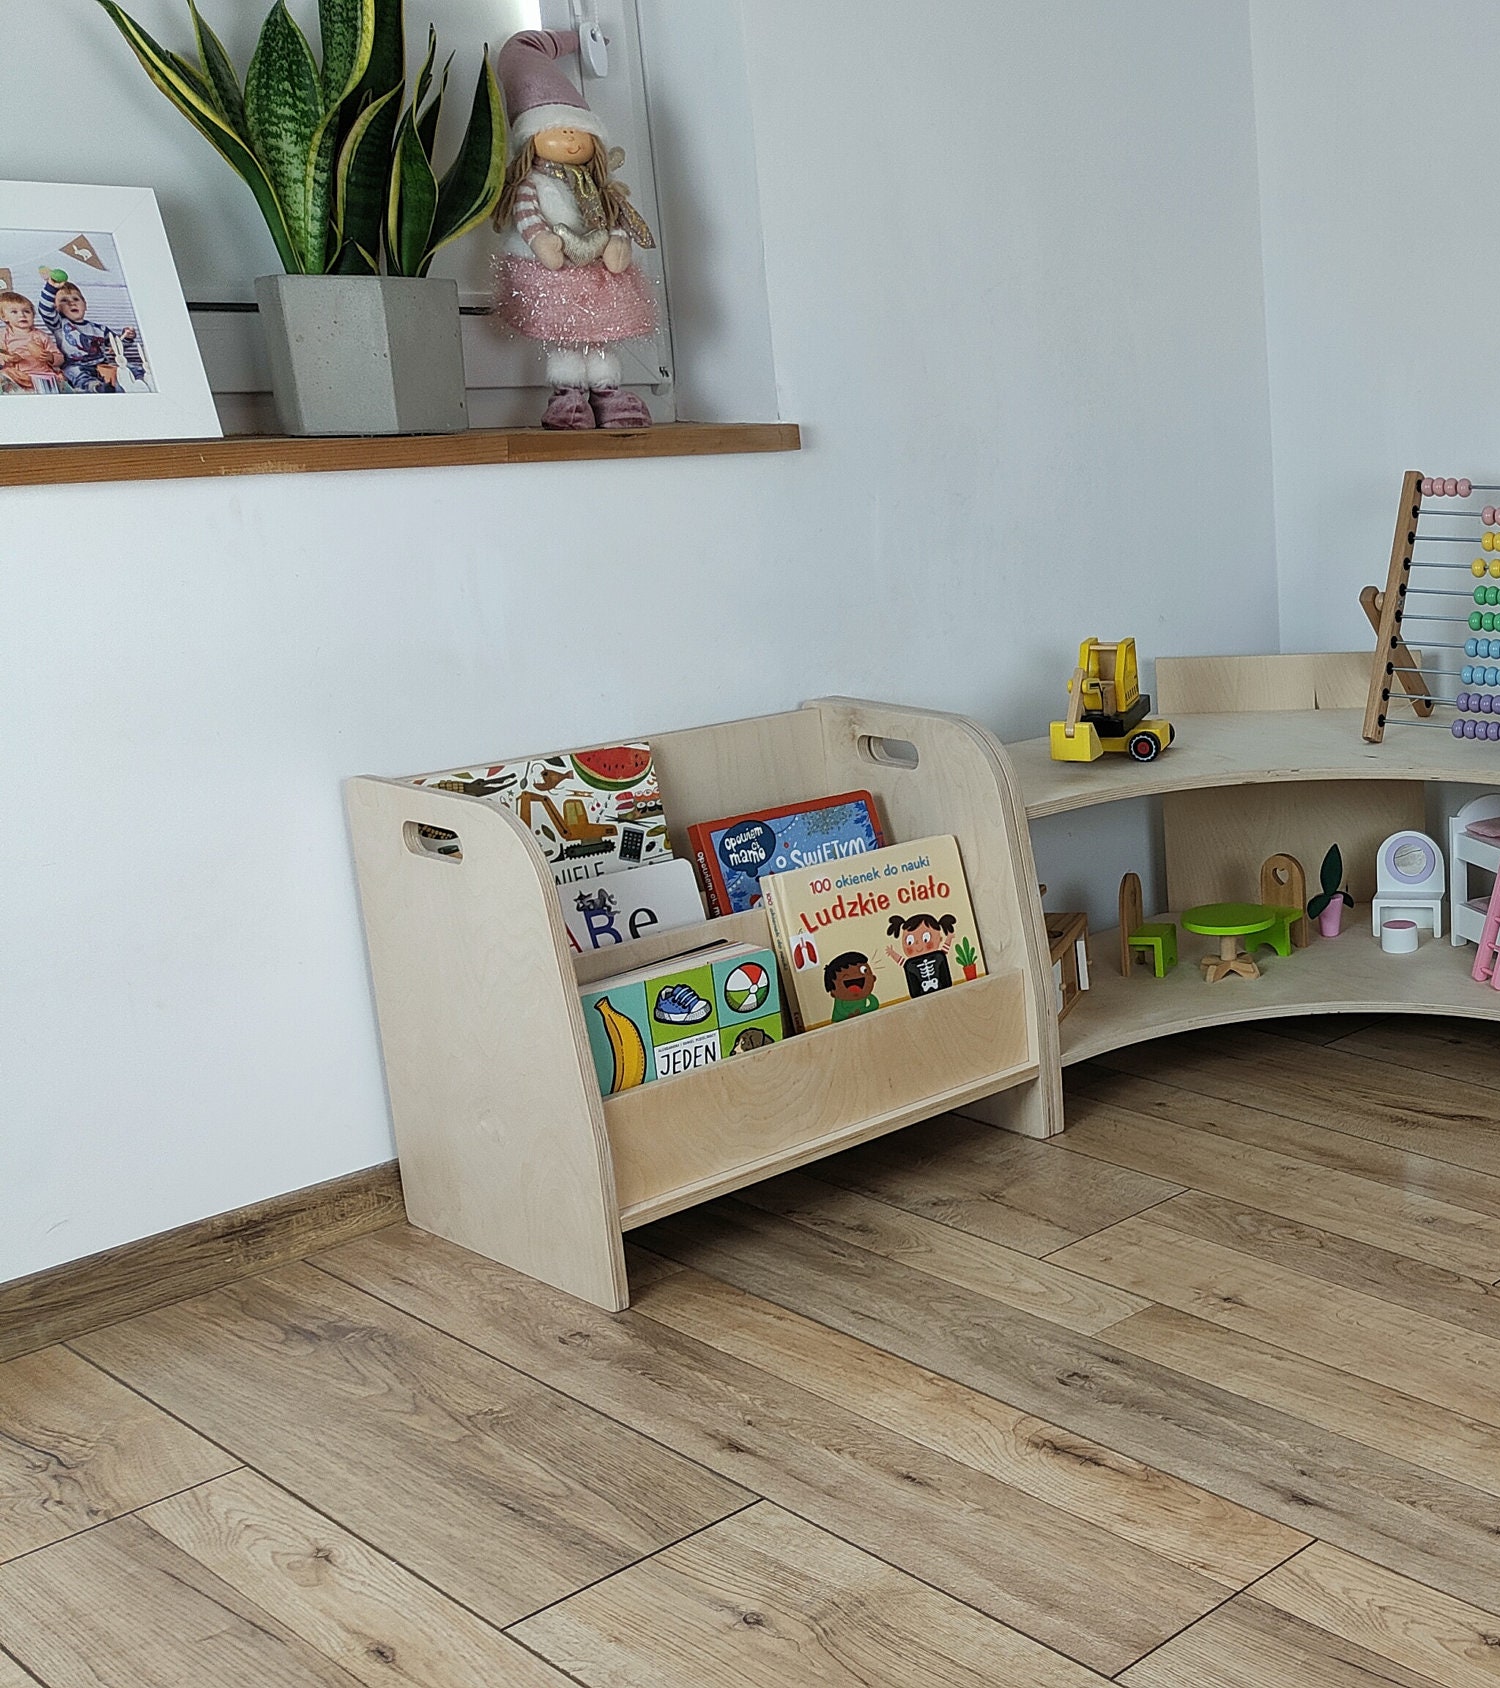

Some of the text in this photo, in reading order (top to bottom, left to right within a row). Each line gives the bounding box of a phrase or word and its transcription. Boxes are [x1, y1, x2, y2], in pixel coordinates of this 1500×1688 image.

[729, 847, 766, 867] mamo
[751, 839, 760, 851] ci
[809, 856, 930, 895] 100 okienek do nauki
[800, 875, 950, 934] Ludzkie ciało
[660, 1041, 716, 1075] JEDEN
